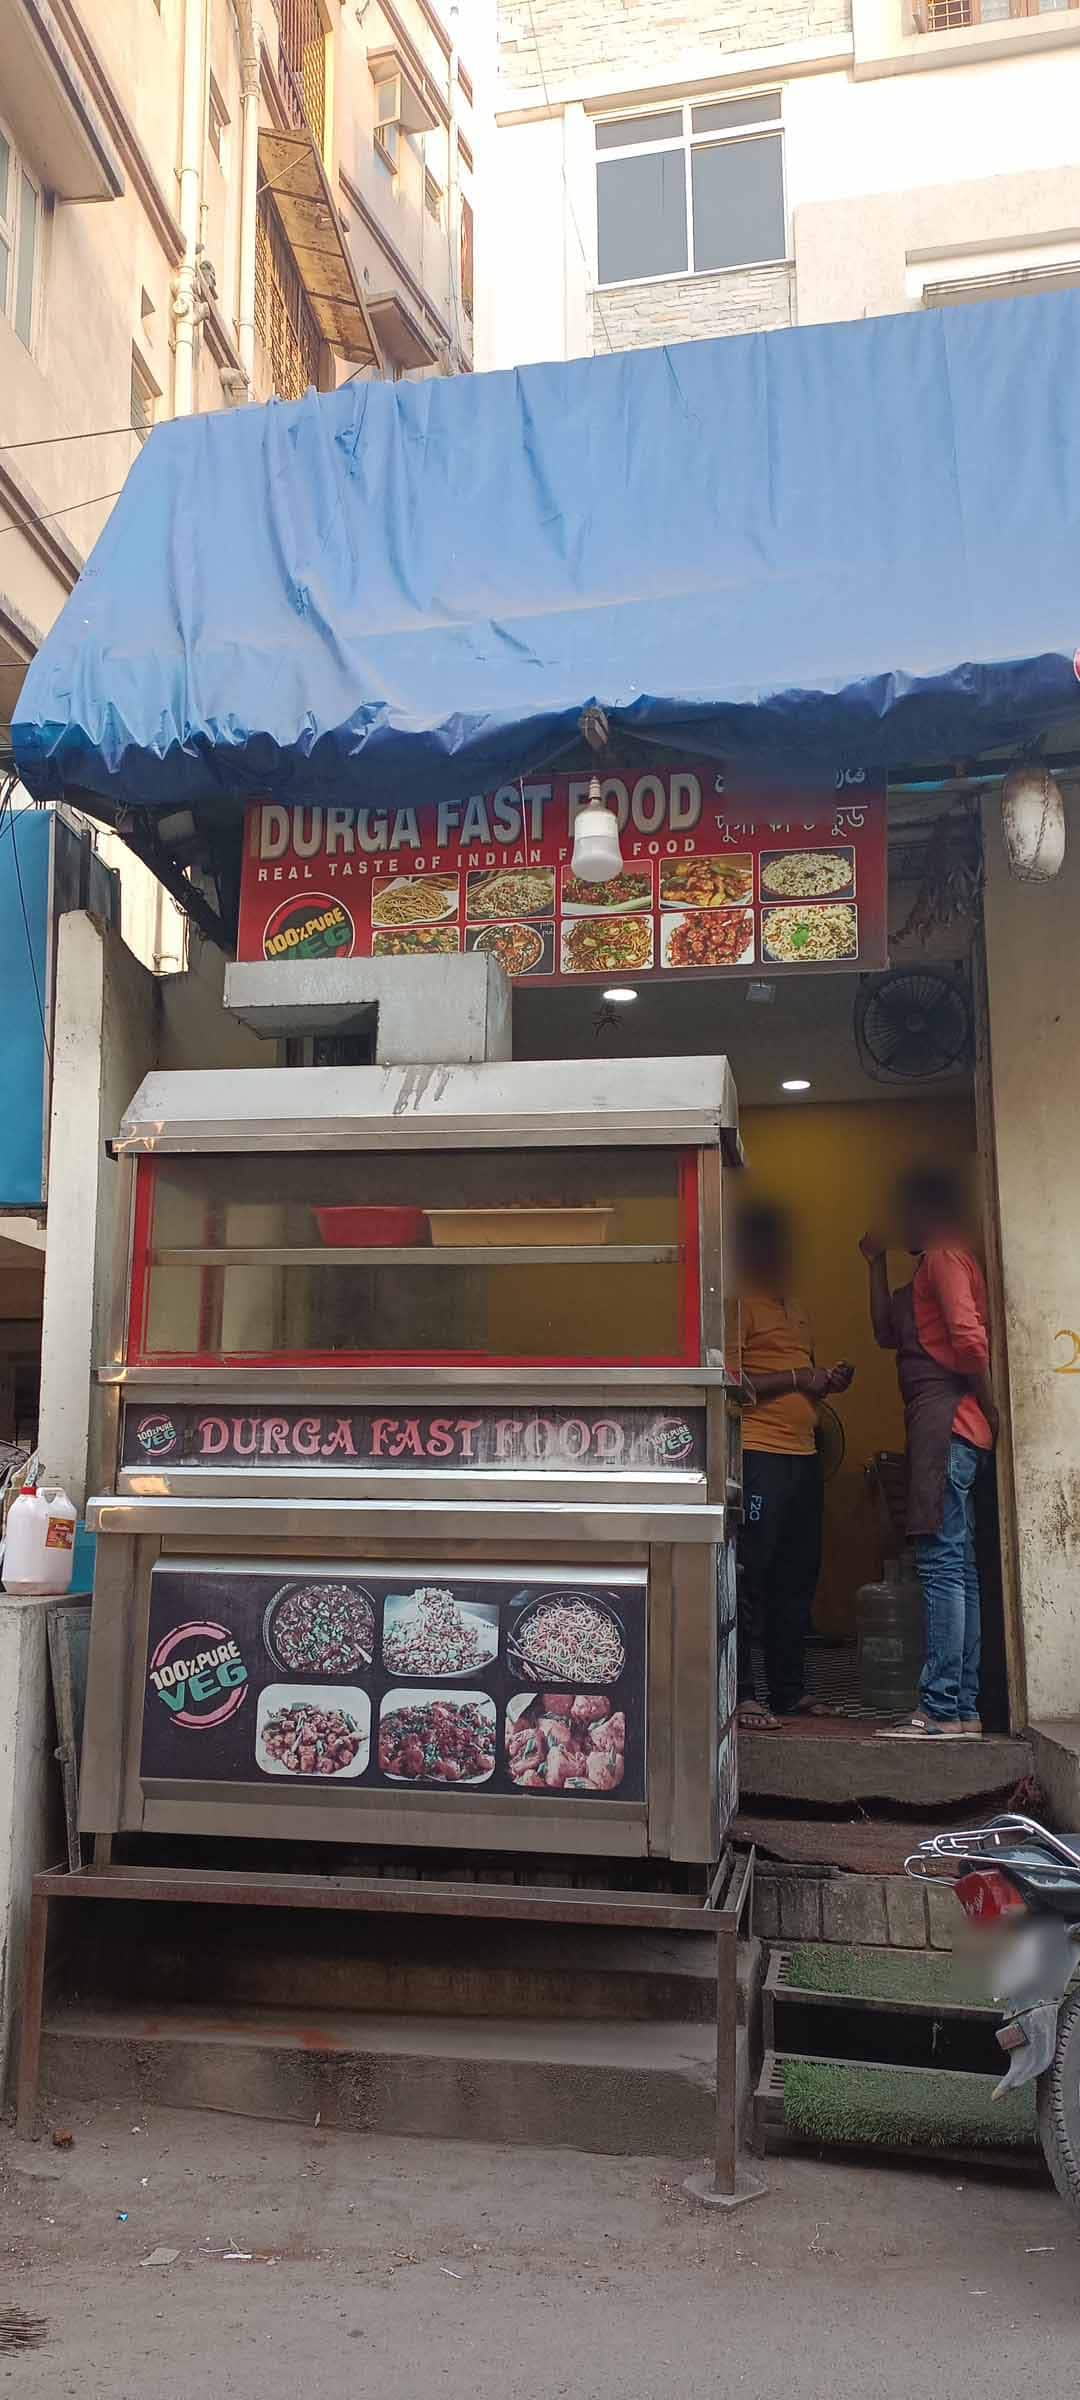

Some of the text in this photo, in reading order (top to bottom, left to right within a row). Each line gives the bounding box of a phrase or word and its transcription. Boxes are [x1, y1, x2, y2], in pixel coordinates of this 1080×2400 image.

[259, 803, 421, 860] DURGA
[437, 783, 552, 848] FAST
[258, 865, 313, 881] REAL
[329, 859, 398, 876] TASTE
[415, 856, 441, 870] OF
[457, 848, 541, 868] INDIAN
[633, 839, 696, 855] FOOD
[140, 1428, 176, 1449] VEG
[198, 1417, 625, 1457] DURGA FAST FOOD
[655, 1431, 693, 1453] VEG
[158, 1658, 248, 1712] VEG
